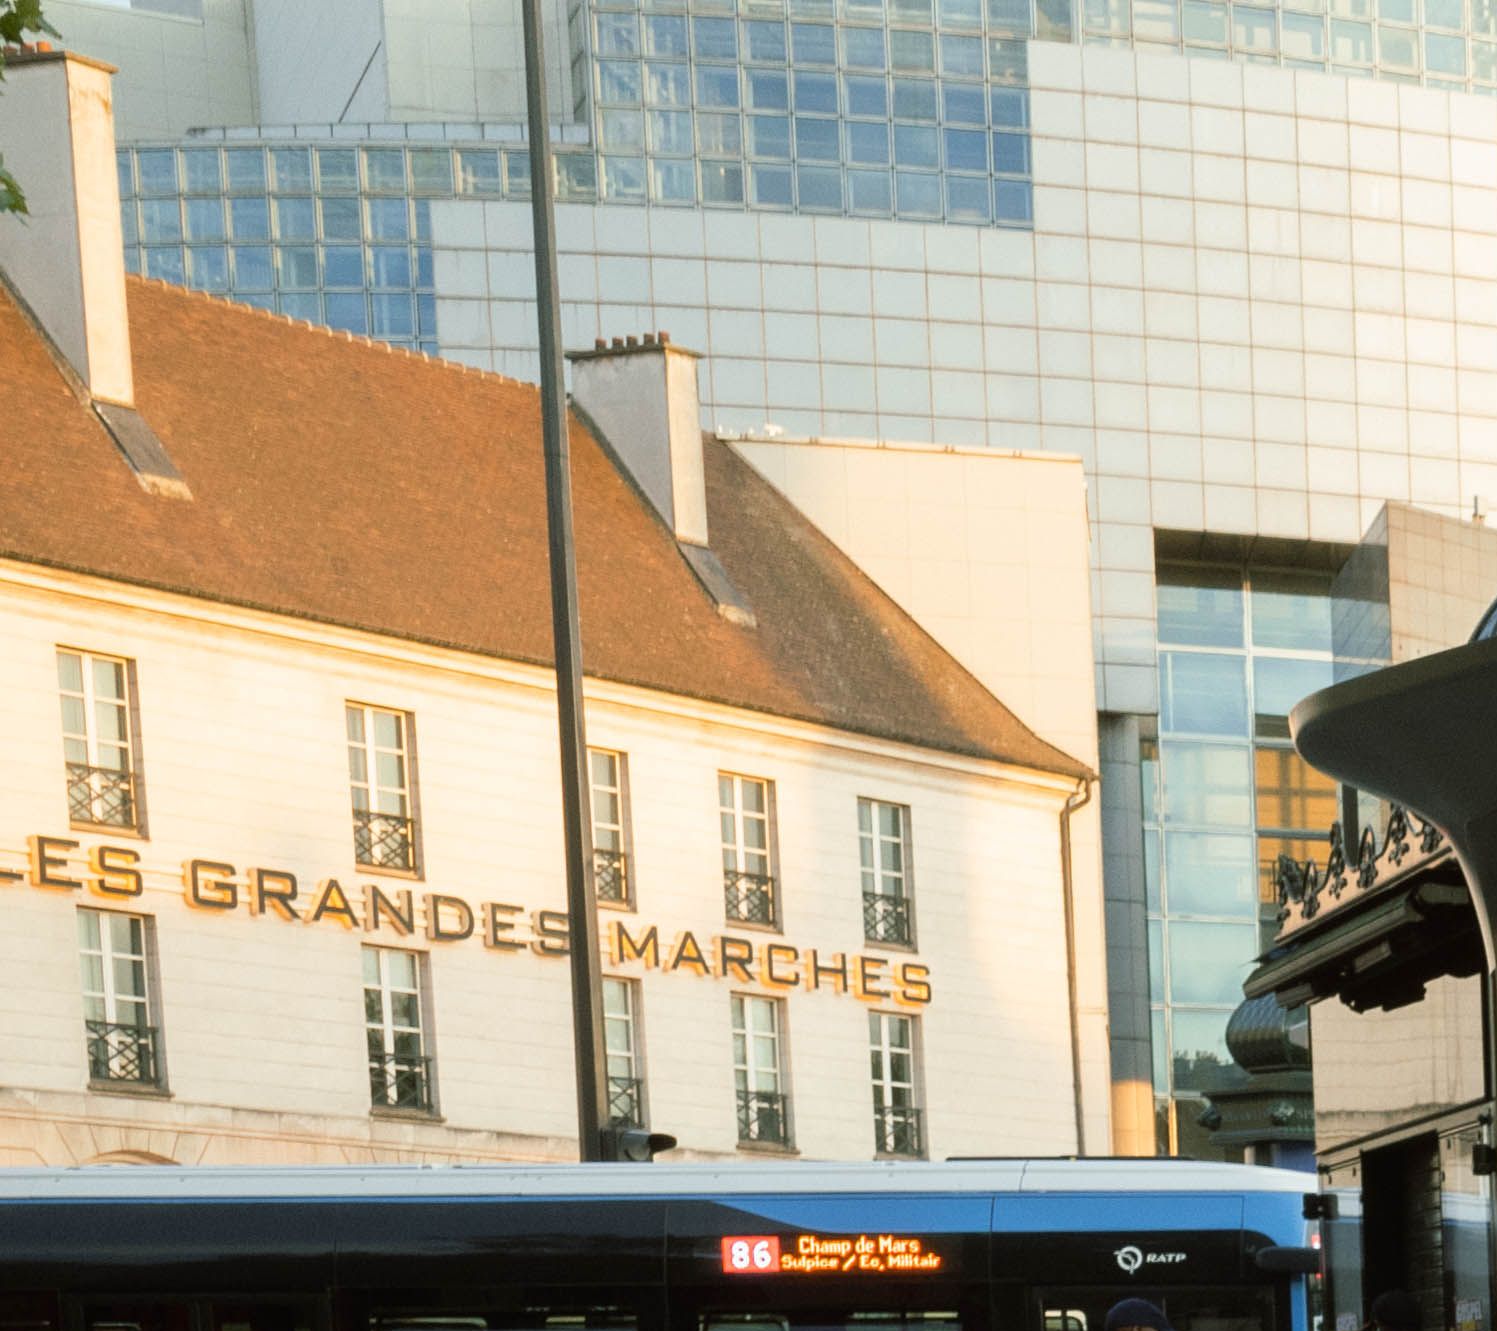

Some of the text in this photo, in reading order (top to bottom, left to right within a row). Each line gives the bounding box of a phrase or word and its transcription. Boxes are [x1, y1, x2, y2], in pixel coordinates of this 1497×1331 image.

[607, 920, 932, 1006] MARCHES
[731, 1240, 772, 1269] 86
[798, 1235, 921, 1256] Champ de Mars
[1146, 1252, 1187, 1264] RATP
